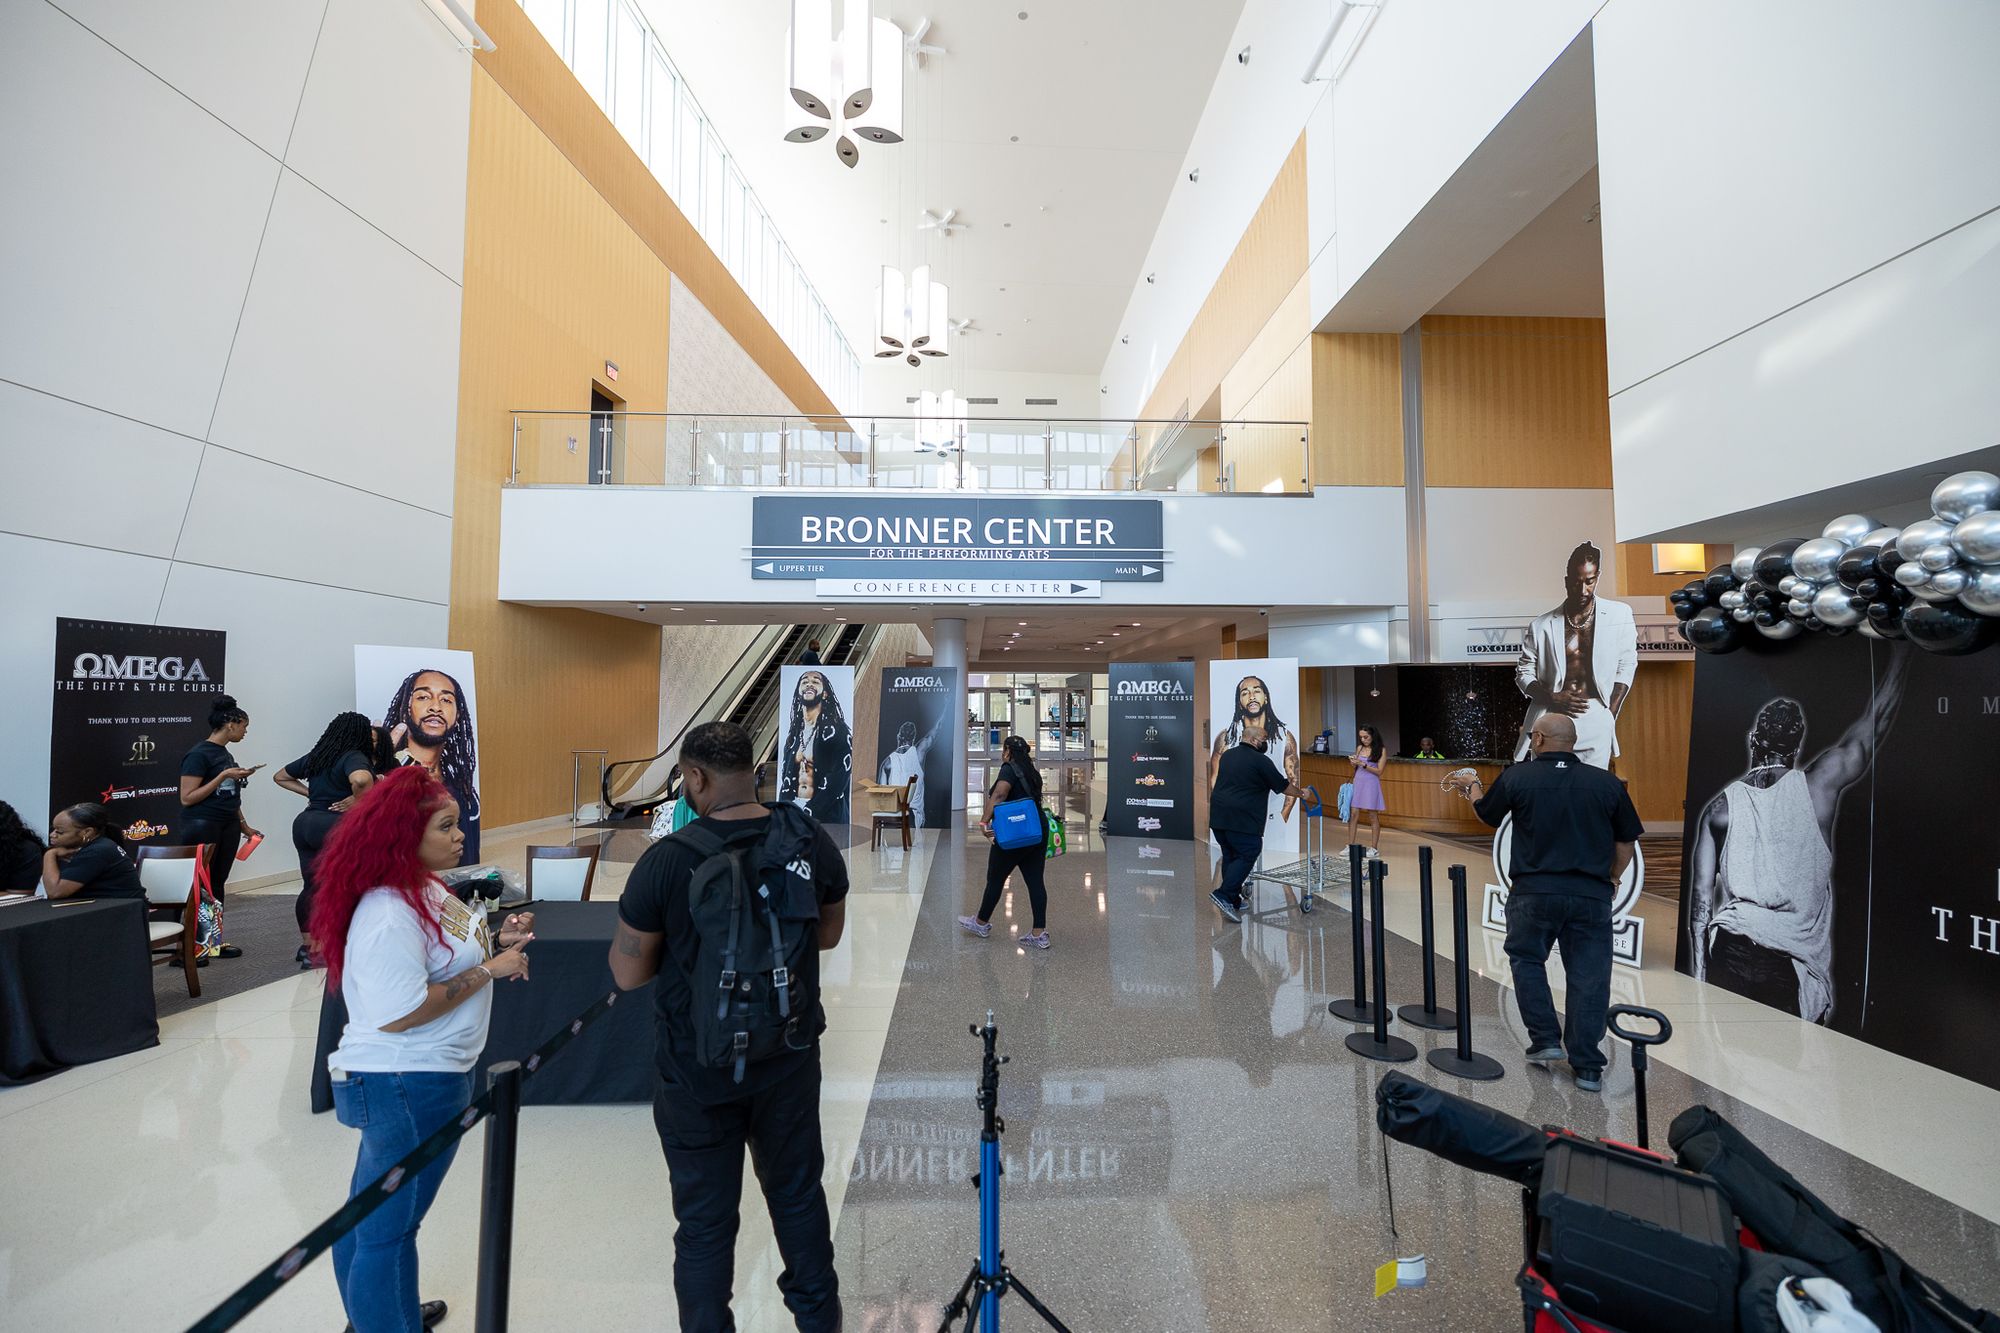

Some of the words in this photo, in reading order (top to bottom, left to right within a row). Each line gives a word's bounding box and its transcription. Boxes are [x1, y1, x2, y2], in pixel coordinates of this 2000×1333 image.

[801, 516, 974, 544] BRONNER
[984, 518, 1116, 545] CENTER
[869, 549, 894, 558] FOR
[900, 549, 923, 558] THE
[929, 549, 1013, 559] PERFORMING
[1018, 550, 1050, 559] ARTS
[779, 564, 805, 573] UPPER
[807, 564, 825, 573] TIER
[853, 582, 977, 593] CONFERENCE
[991, 583, 1061, 593] CENTER
[1638, 643, 1694, 651] SECURITY
[56, 680, 84, 691] THE
[93, 681, 125, 691] GIFT
[133, 682, 140, 691] &
[149, 682, 175, 692] THE
[183, 683, 224, 692] CURSE
[111, 790, 135, 799] SEM
[138, 786, 178, 796] SUPERSTAR
